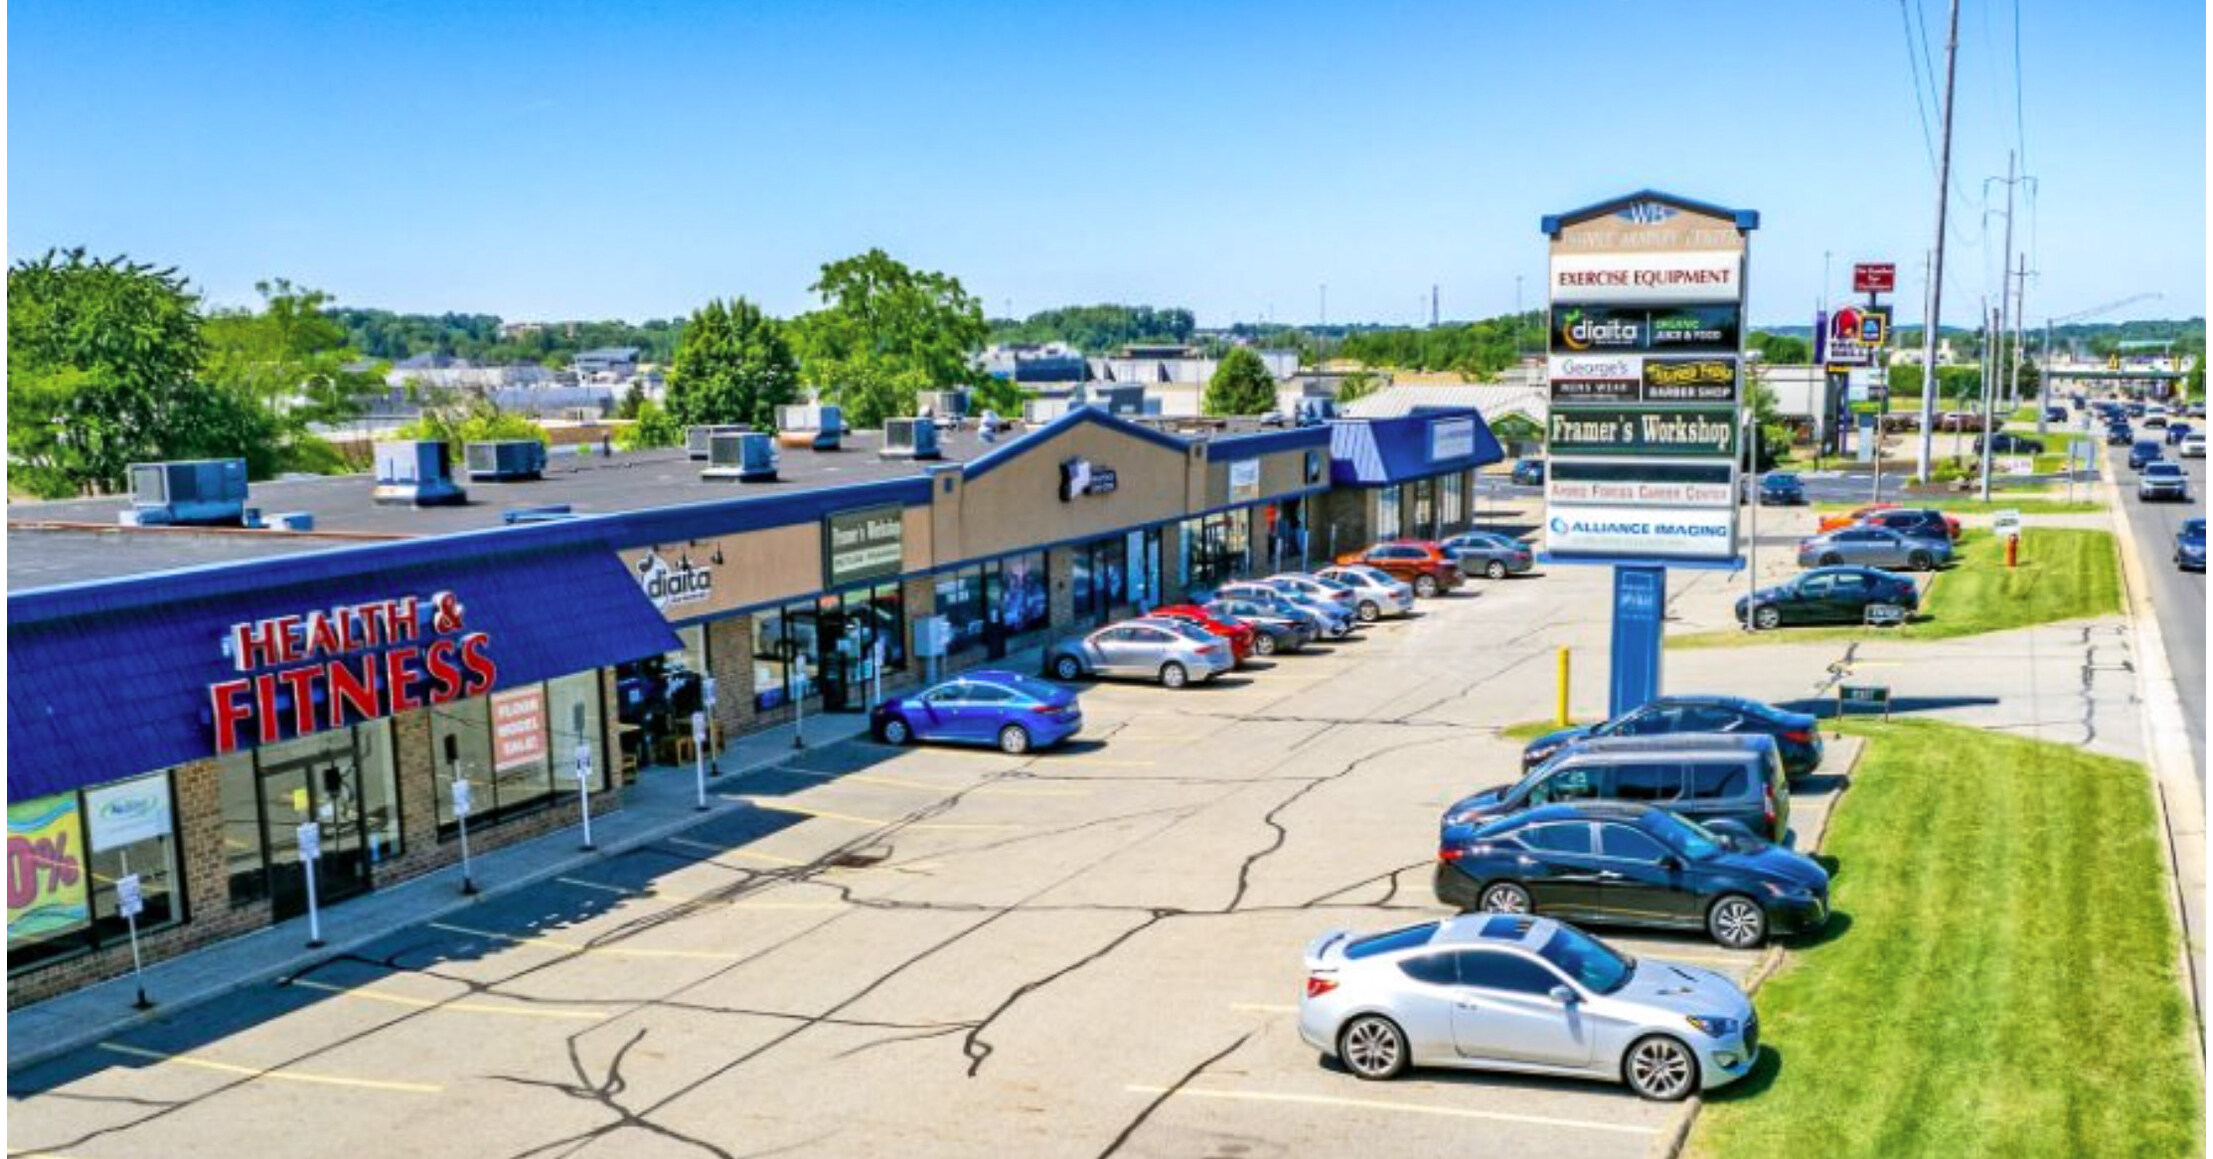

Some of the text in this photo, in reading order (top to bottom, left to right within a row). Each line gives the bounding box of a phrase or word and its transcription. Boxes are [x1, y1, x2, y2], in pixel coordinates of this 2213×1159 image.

[1559, 269, 1730, 287] EXERCISE EQUIPMENT
[1562, 358, 1628, 377] George's
[1649, 386, 1731, 398] BARBER SHOP
[1552, 413, 1731, 451] Framer's Workshop
[1572, 521, 1727, 537] ALLIANCE IMAGING
[231, 590, 464, 671] HEALTH &
[210, 632, 497, 758] FITNESS
